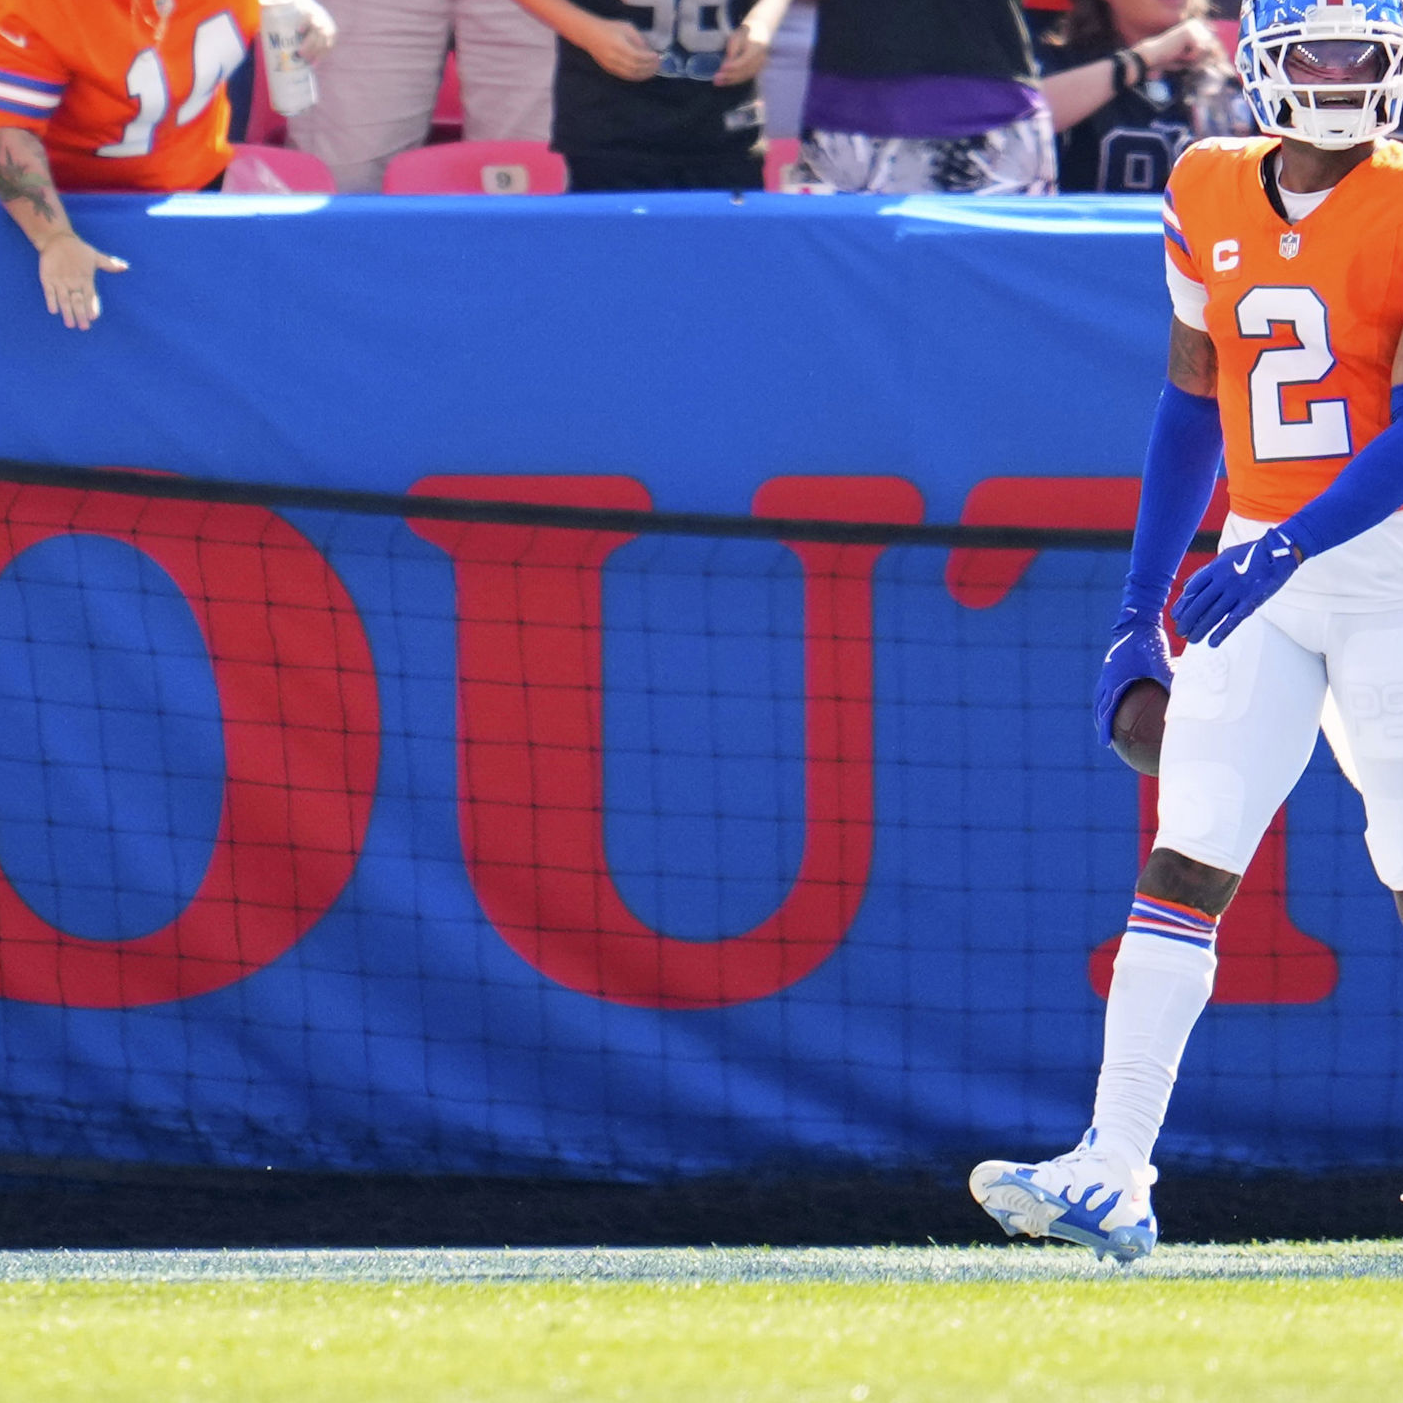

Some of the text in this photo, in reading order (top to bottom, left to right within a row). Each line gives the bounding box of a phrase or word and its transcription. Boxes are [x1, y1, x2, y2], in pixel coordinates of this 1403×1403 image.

[96, 9, 246, 158] 14
[1212, 238, 1240, 273] C
[1235, 285, 1352, 464] 2
